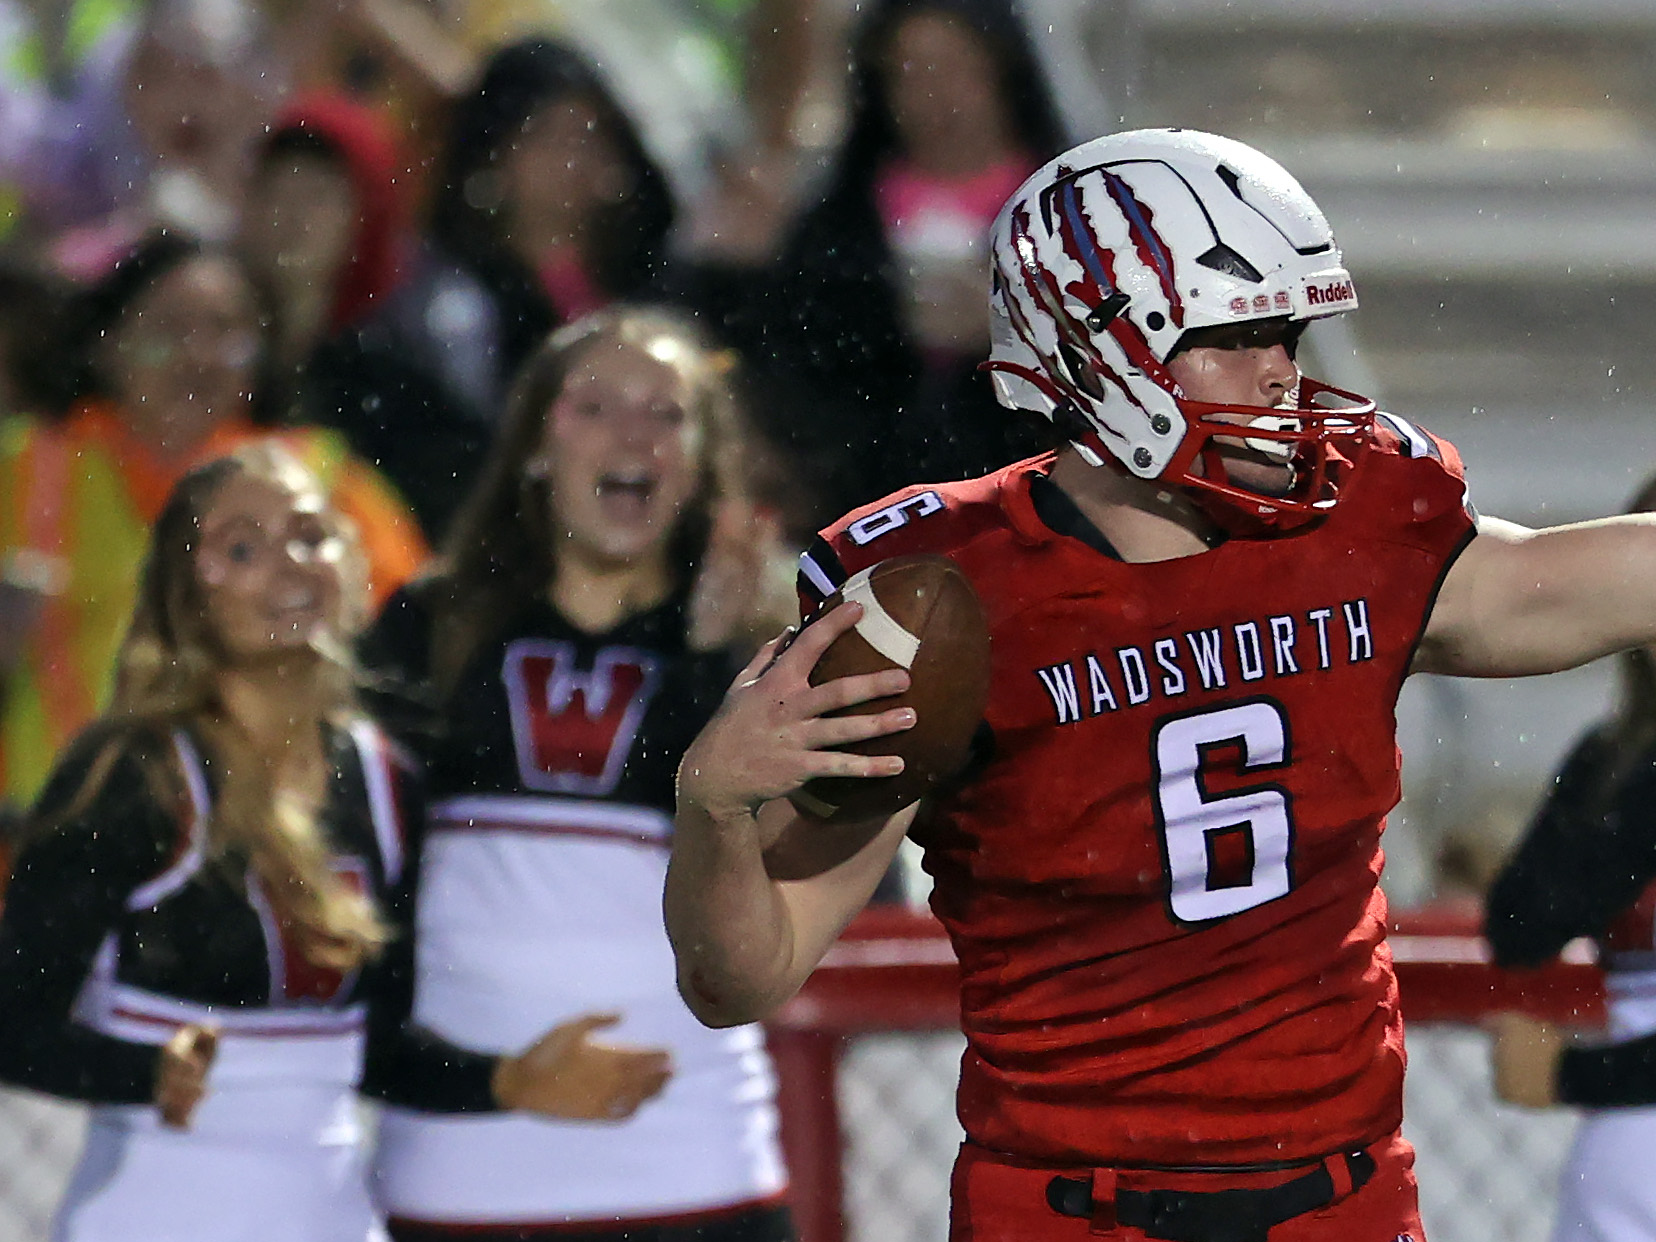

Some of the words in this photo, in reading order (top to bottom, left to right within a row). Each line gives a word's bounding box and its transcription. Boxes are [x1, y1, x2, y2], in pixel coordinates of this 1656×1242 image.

[1305, 279, 1354, 306] Riddell
[847, 490, 946, 546] 6
[501, 637, 663, 796] W
[1037, 599, 1373, 725] WADSWORTH
[1153, 698, 1294, 924] 6
